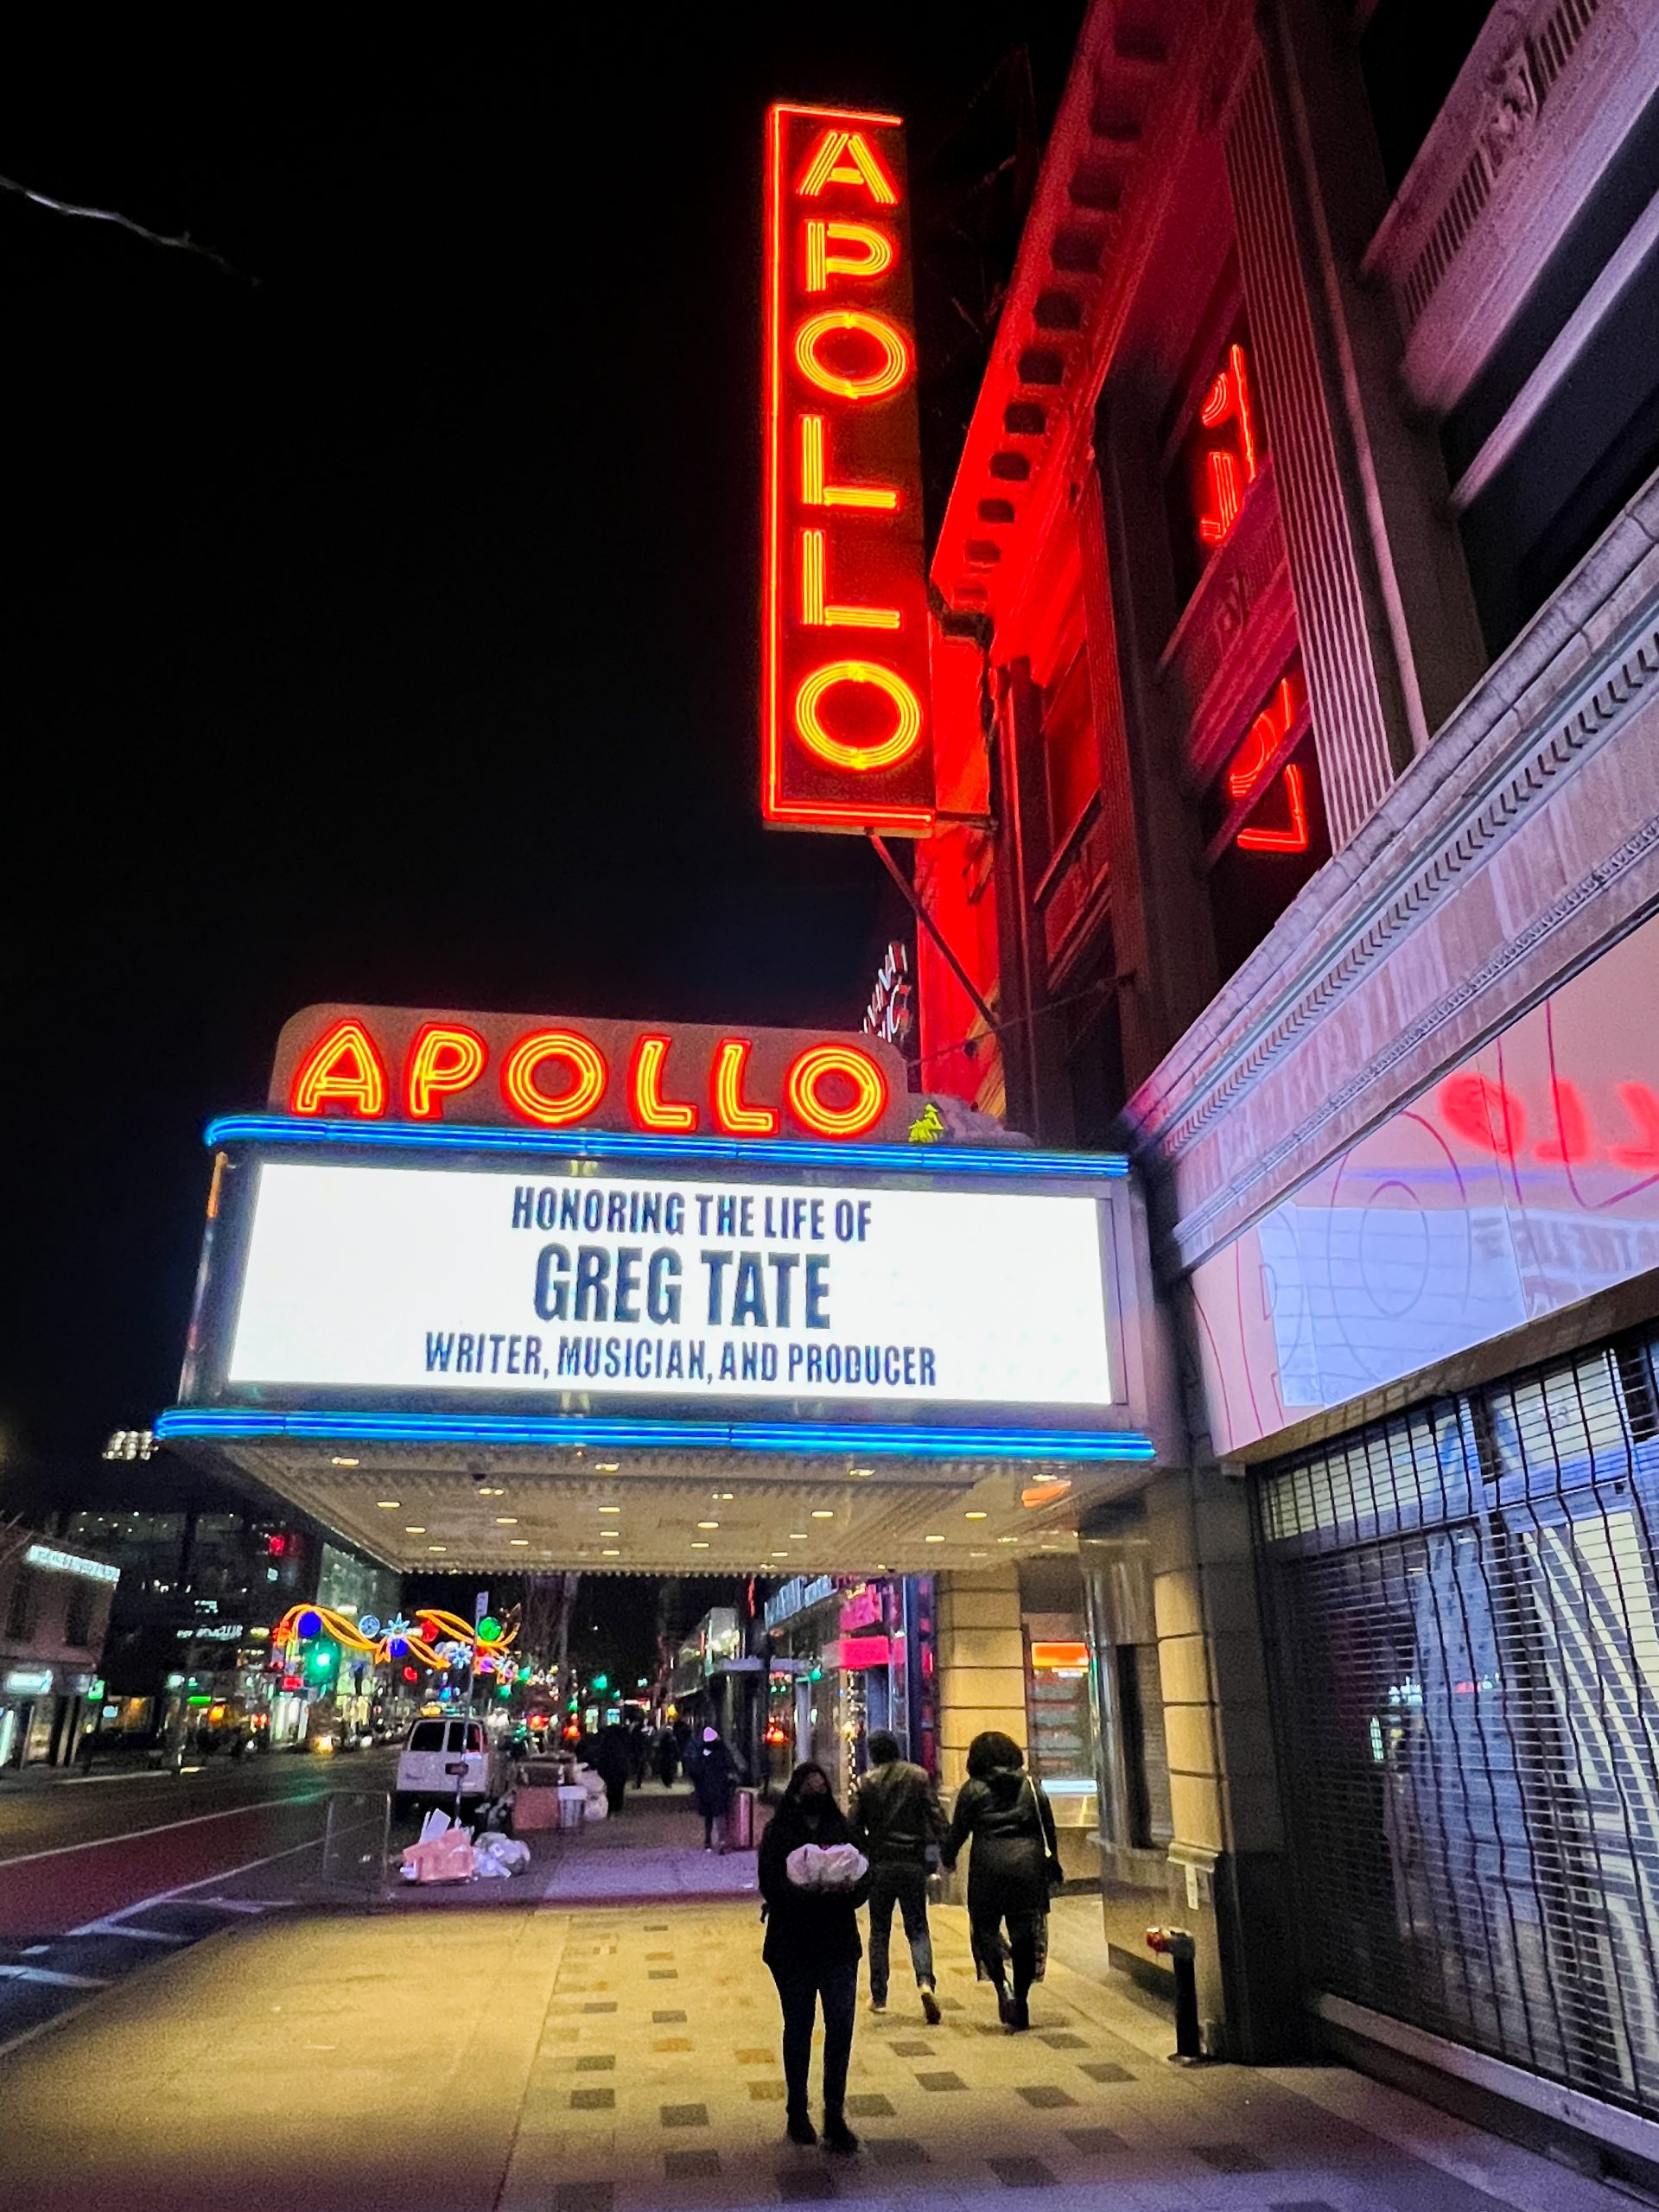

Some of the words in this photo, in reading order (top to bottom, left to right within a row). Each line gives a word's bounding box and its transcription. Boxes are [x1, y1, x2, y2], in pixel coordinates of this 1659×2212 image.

[794, 130, 921, 771] APOLLO
[290, 1019, 888, 1137] APOLLO
[512, 1185, 685, 1235] HONORING
[696, 1193, 754, 1236] THE
[764, 1197, 825, 1240] LIFE
[835, 1199, 872, 1242] OF
[533, 1243, 683, 1325] GREG
[700, 1249, 830, 1330] TATE
[425, 1332, 550, 1380] WRITER,
[557, 1336, 713, 1384] MUSICIAN,
[719, 1341, 778, 1382] AND
[787, 1344, 936, 1386] PRODUCER
